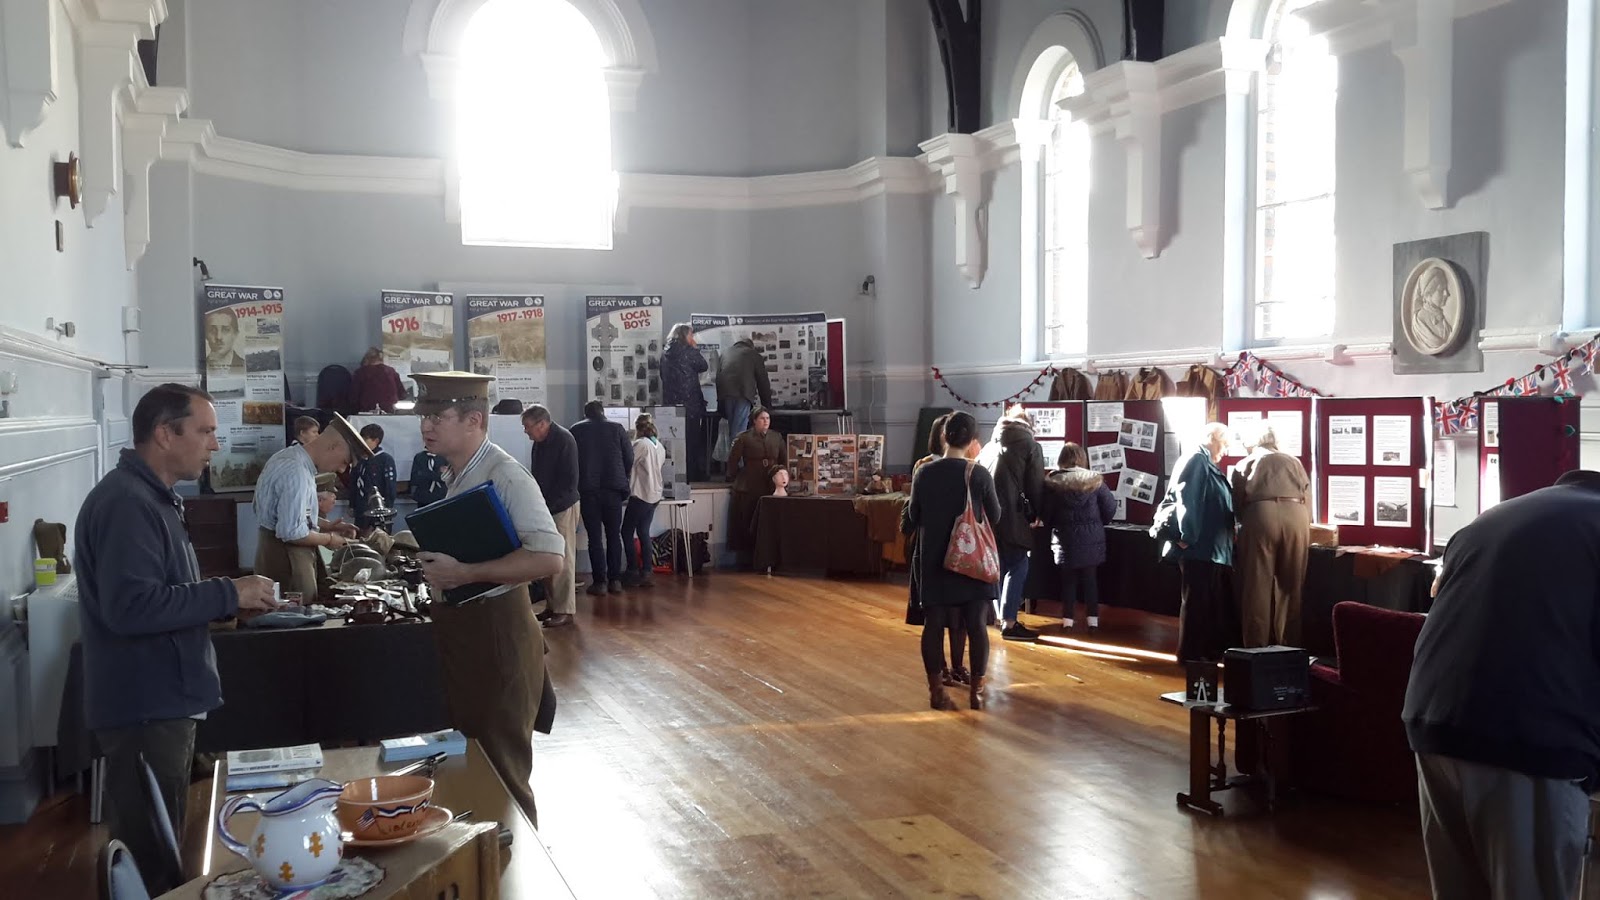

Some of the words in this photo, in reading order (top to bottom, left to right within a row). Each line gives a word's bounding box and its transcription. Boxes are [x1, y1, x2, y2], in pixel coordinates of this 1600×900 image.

[207, 290, 237, 299] GREAT
[238, 292, 258, 300] WAR
[235, 303, 283, 318] 1914-1915
[620, 309, 651, 321] LOCAL
[388, 316, 420, 333] 1916
[624, 318, 651, 330] BOYS
